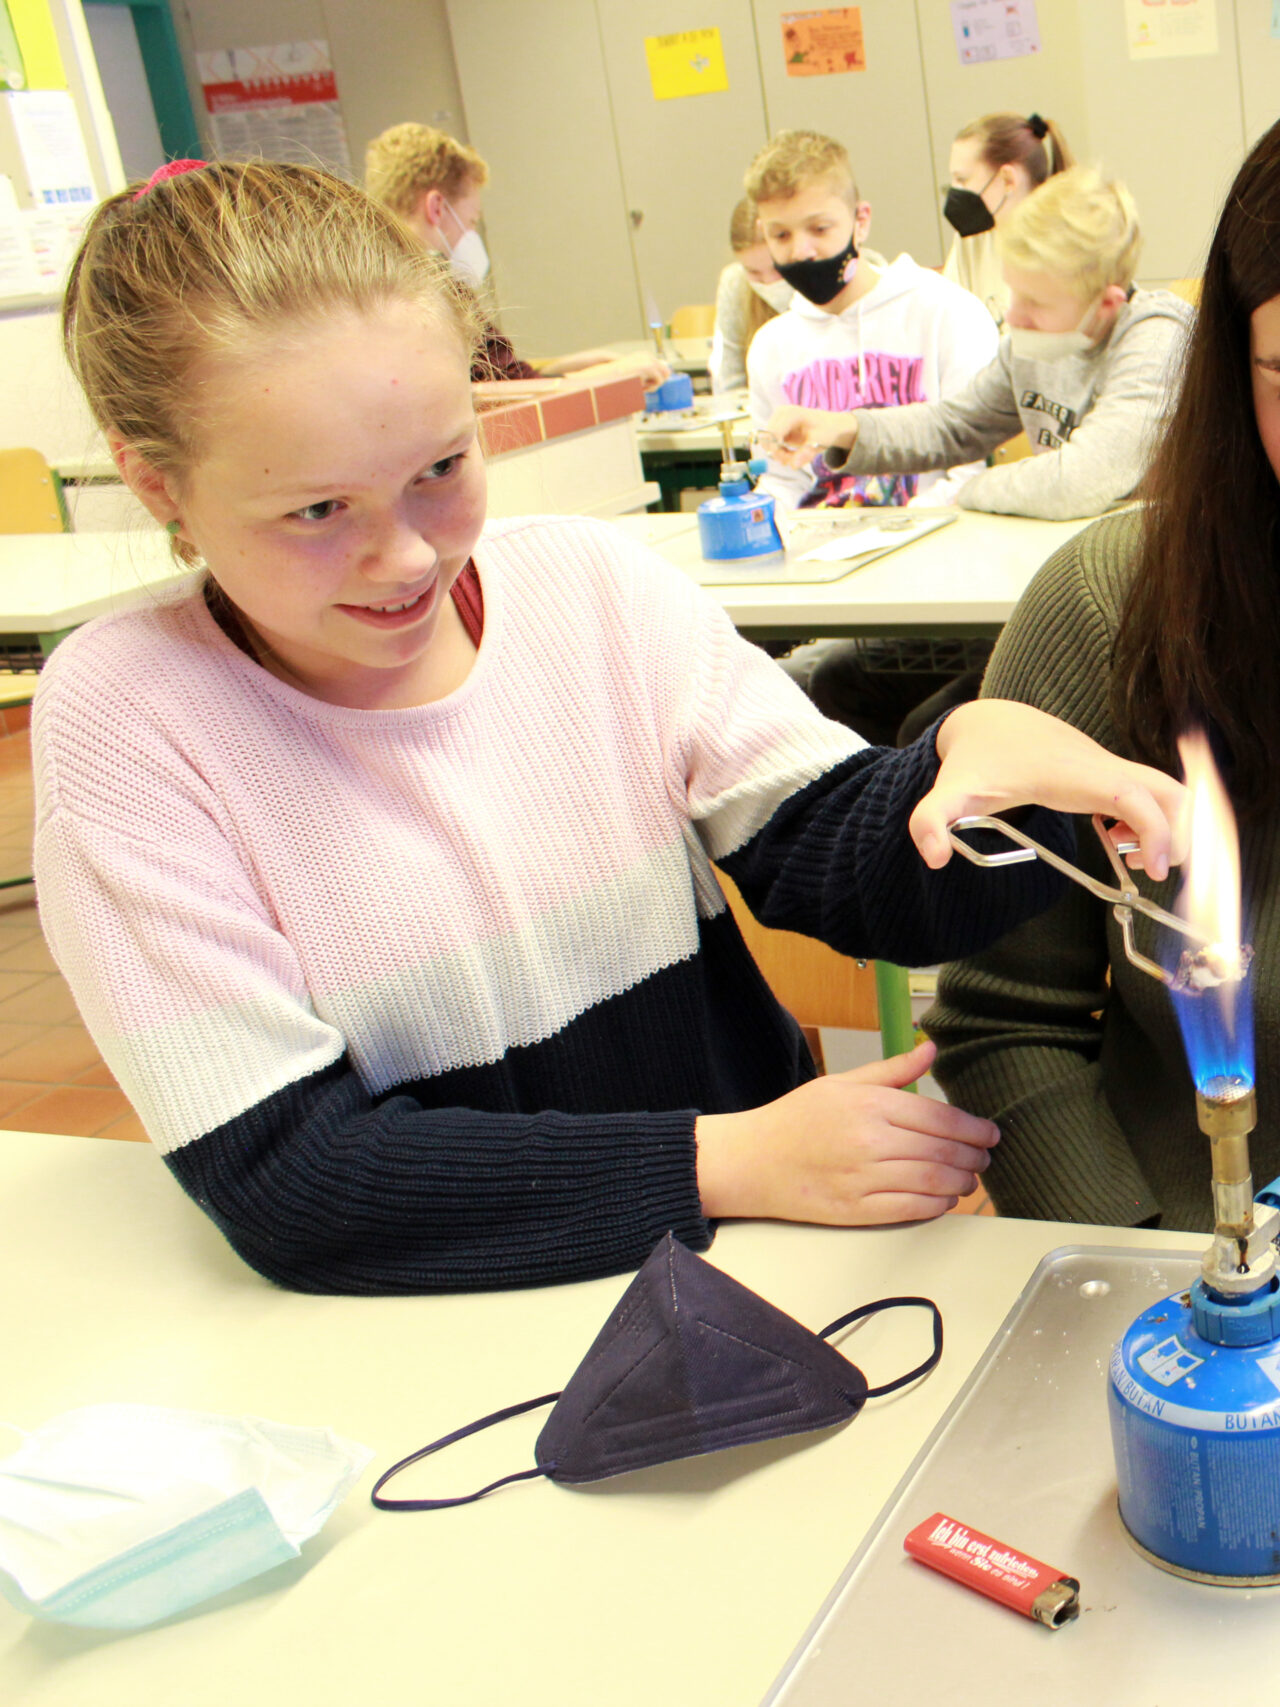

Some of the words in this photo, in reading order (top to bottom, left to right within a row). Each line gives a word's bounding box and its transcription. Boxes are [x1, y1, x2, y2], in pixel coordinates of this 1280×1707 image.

[928, 1518, 956, 1545] Ich
[947, 1527, 970, 1550] bin
[966, 1540, 993, 1557] erst
